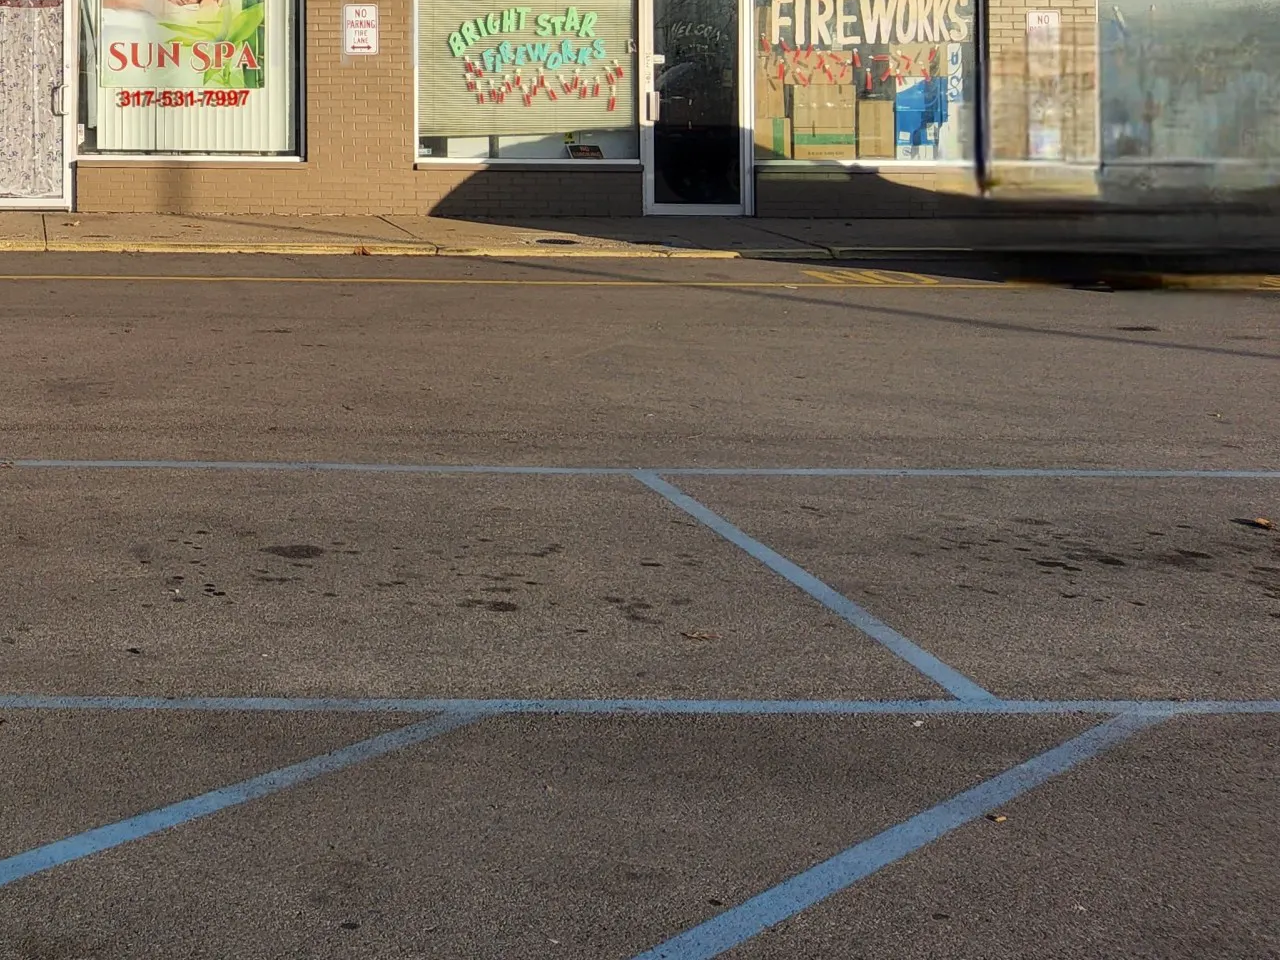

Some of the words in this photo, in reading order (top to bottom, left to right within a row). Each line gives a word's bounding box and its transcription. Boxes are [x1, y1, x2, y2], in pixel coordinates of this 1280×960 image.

[354, 8, 367, 18] NO
[1037, 14, 1050, 25] NO
[346, 19, 376, 29] PARKING
[354, 29, 368, 37] FIRE
[448, 6, 532, 57] BRIGHT
[535, 6, 598, 37] STAR
[108, 42, 180, 72] SUN
[190, 42, 260, 72] SPA
[481, 38, 606, 73] FIREWORKS
[117, 90, 250, 107] 317-531-7997
